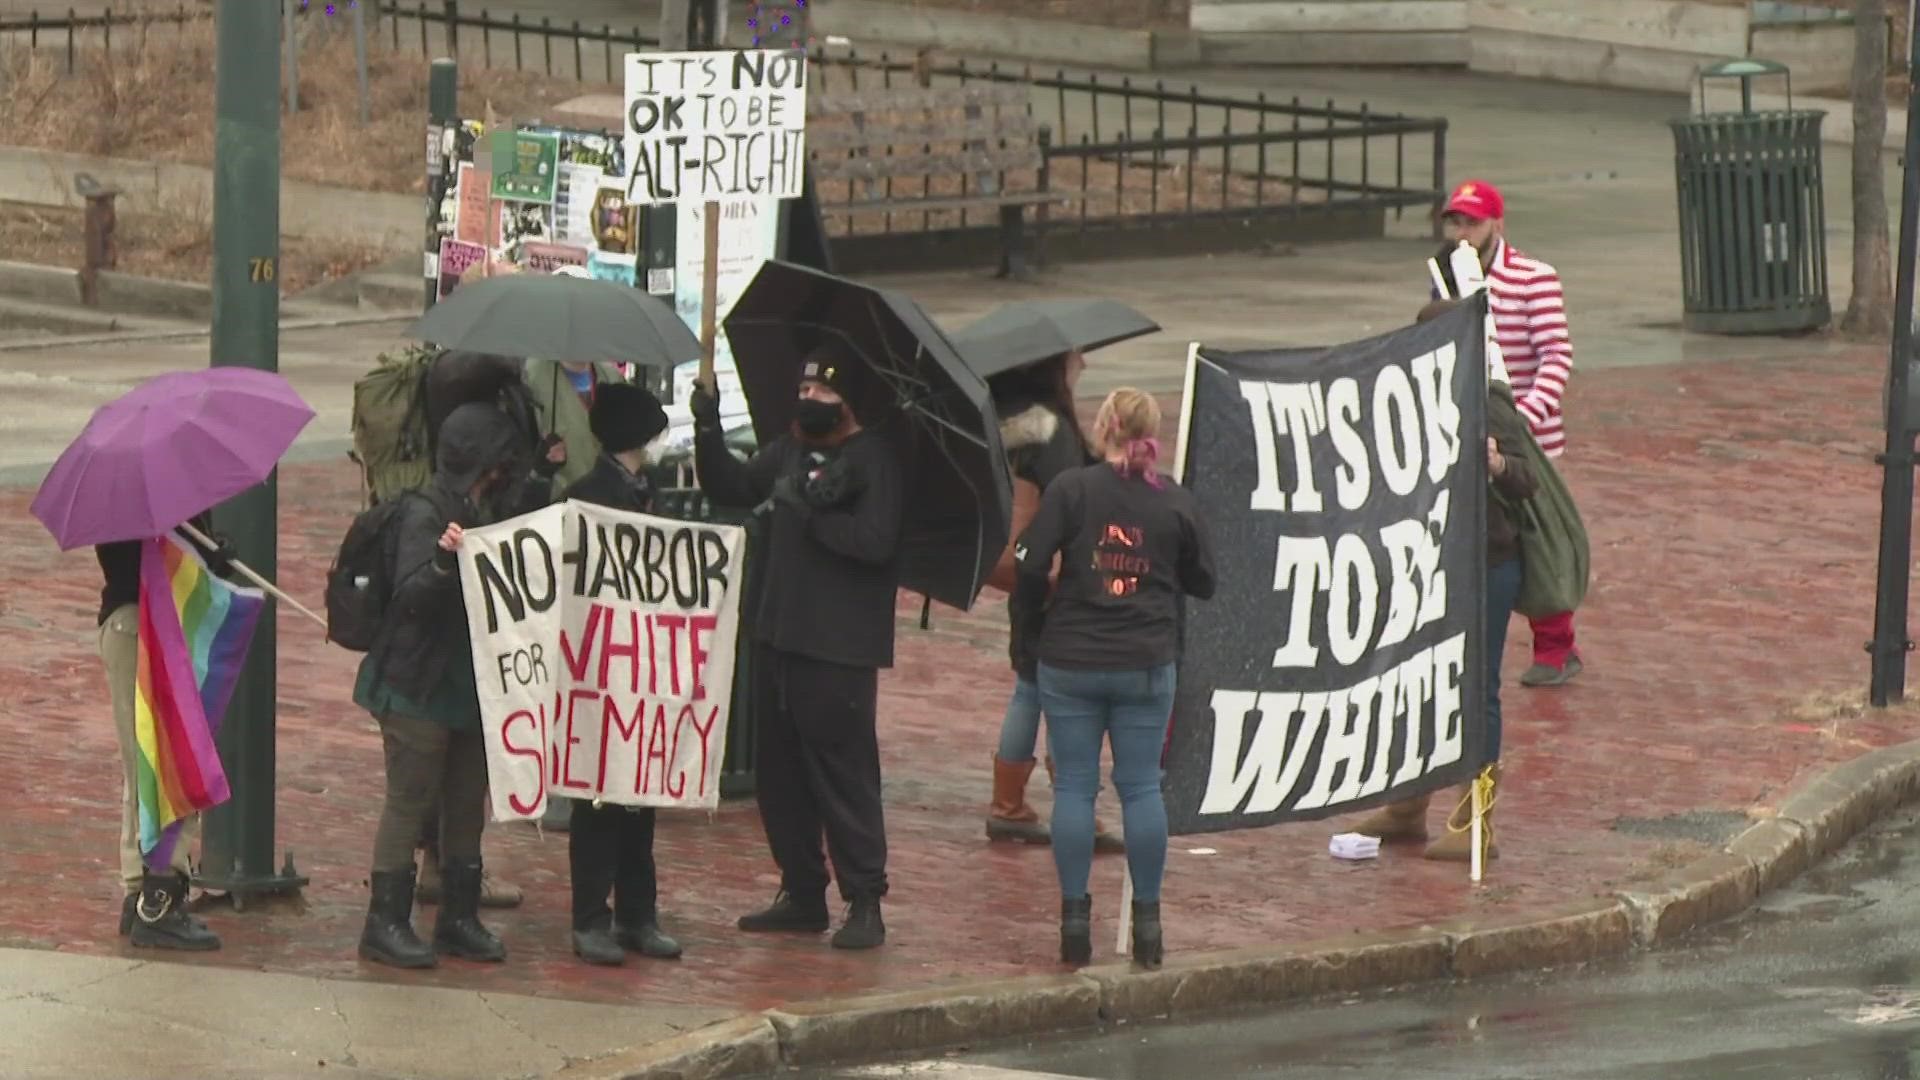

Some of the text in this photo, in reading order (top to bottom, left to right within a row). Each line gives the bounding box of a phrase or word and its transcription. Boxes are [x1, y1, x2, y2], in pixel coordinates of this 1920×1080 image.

[628, 93, 786, 134] OK TO BE
[637, 50, 804, 95] IT'S NOT
[627, 128, 805, 200] ALT-RIGHT
[249, 258, 273, 283] 76
[1239, 340, 1462, 513] IT'S OK
[474, 513, 730, 634] NO HARBOR
[1272, 488, 1451, 668] TO BE
[497, 643, 549, 694] FOR
[502, 689, 719, 816] SEMACY
[1198, 631, 1467, 816] WHITE
